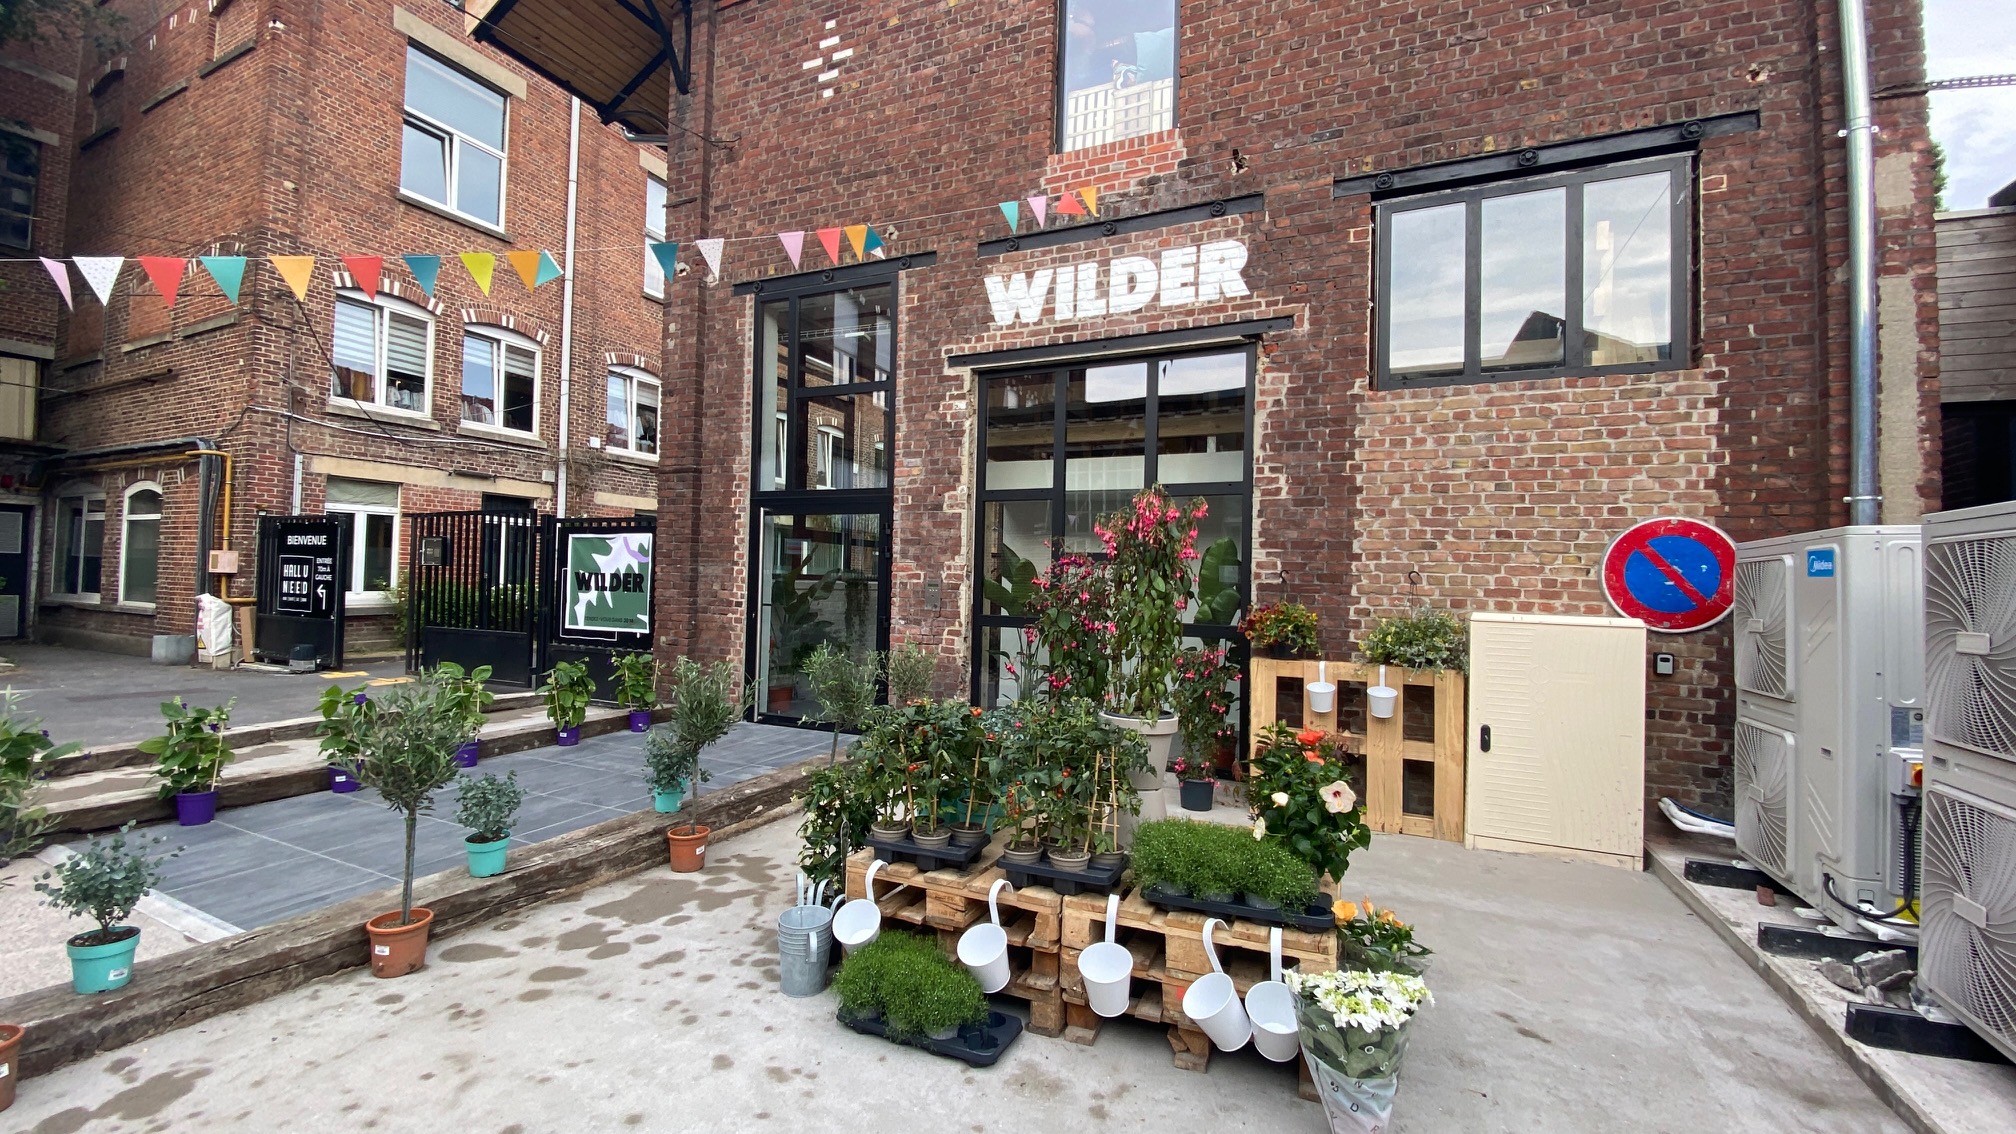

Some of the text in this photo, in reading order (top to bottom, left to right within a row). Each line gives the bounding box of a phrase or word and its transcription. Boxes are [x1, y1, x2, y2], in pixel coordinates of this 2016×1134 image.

[984, 240, 1250, 326] WILDER
[287, 535, 327, 545] BIENVENUE
[283, 564, 309, 578] HALL U
[575, 571, 645, 593] WILDER
